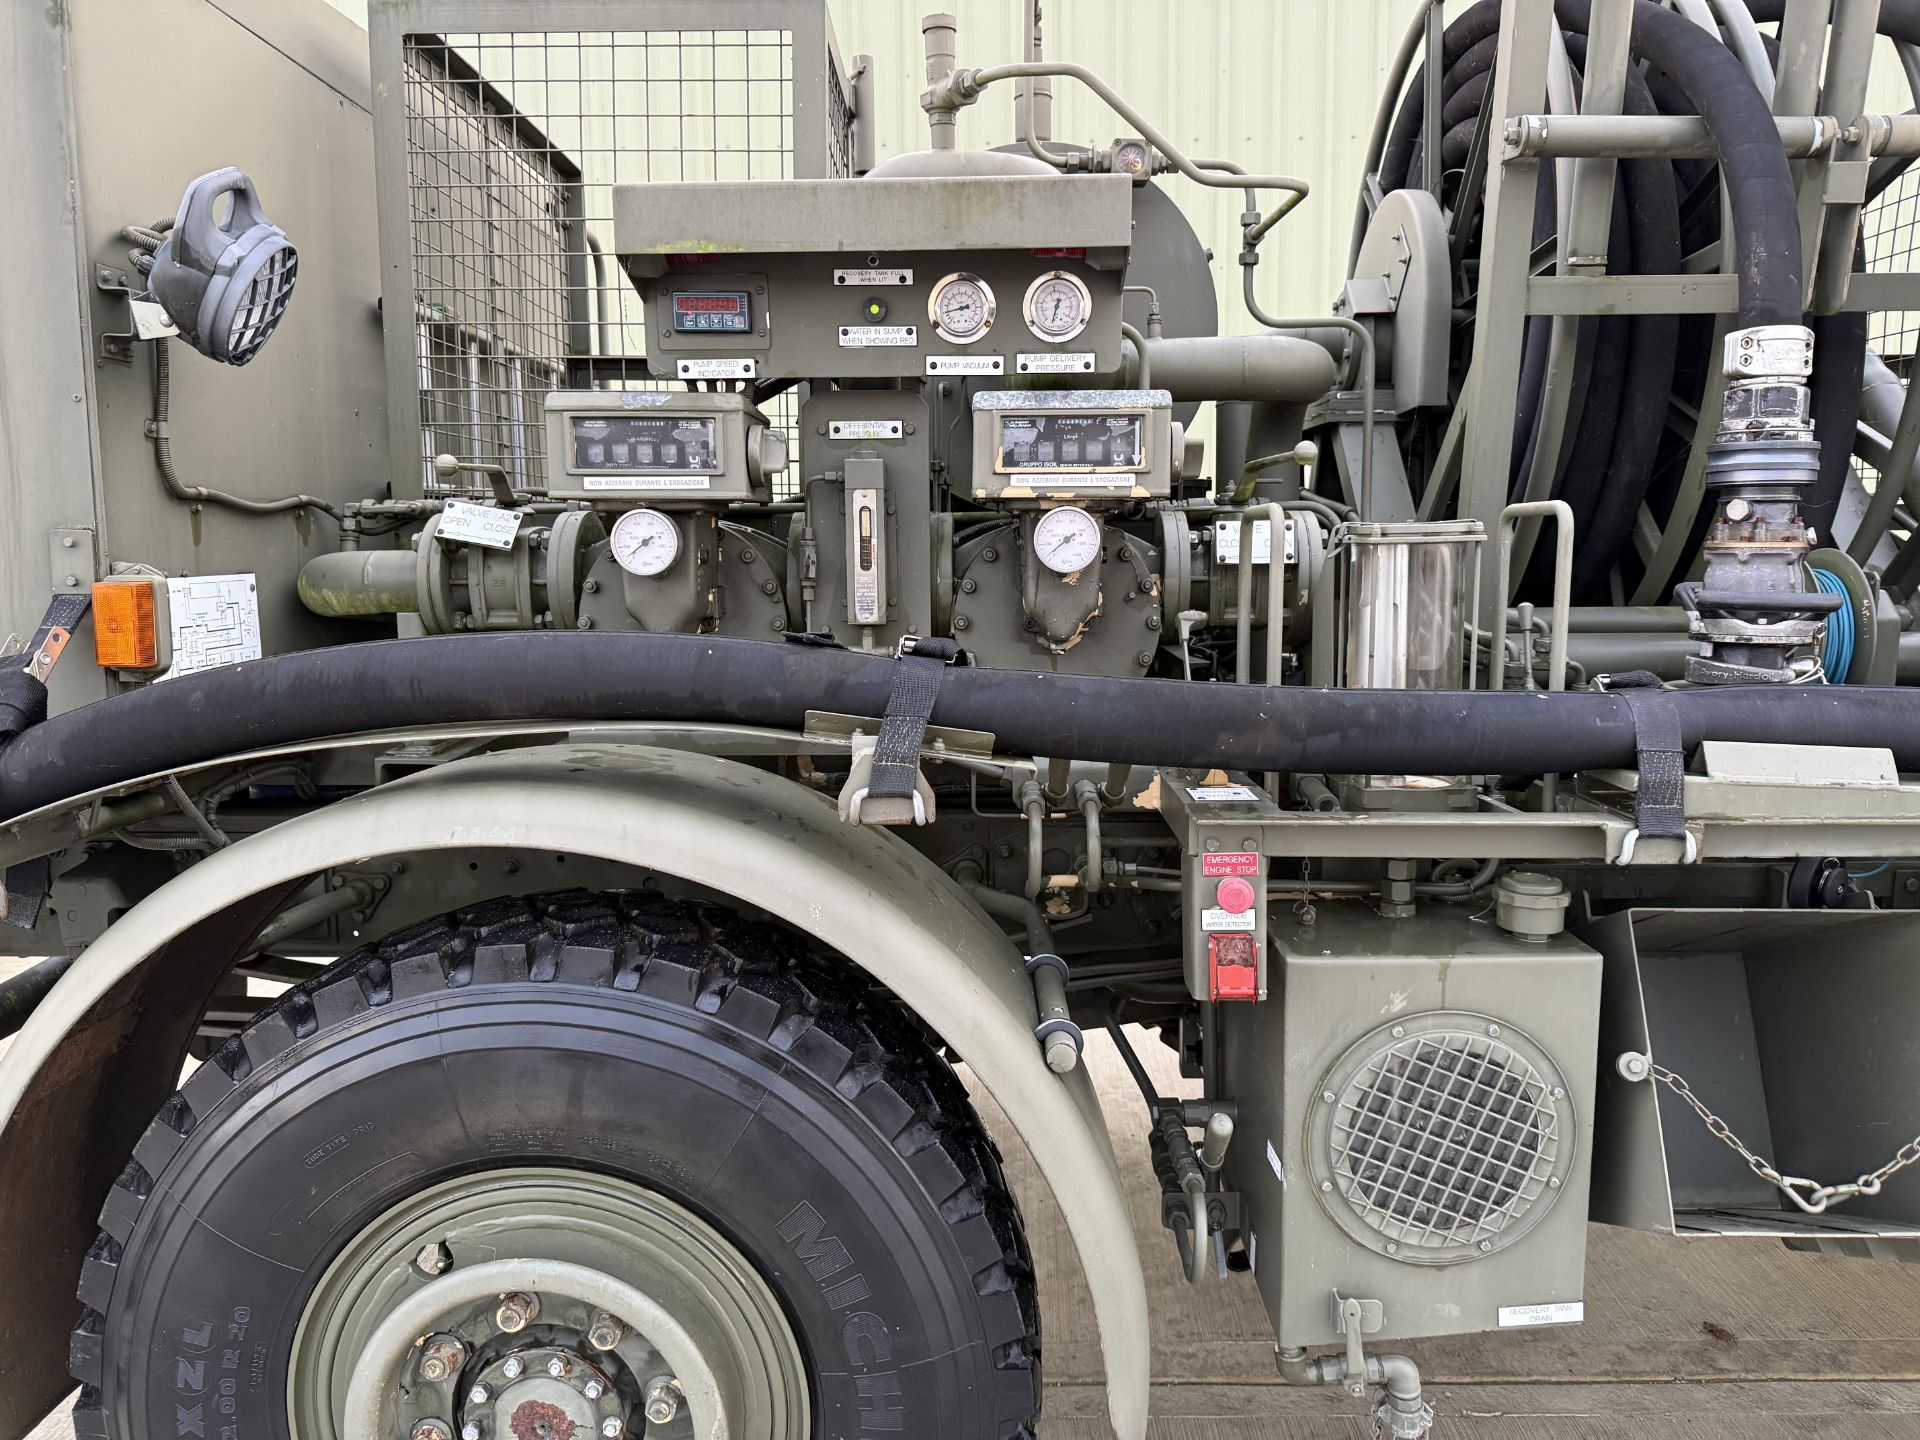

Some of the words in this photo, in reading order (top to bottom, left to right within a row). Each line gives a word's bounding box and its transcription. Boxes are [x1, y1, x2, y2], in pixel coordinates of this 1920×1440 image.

[1049, 354, 1087, 362] DELIVERY
[462, 507, 491, 519] VALVE
[498, 513, 512, 522] A2
[443, 515, 471, 527] OPEN
[483, 522, 516, 534] CLOSE
[1206, 855, 1255, 864] EMERGENCY
[1204, 866, 1233, 874] ENGINE
[1236, 866, 1257, 874] STOP
[325, 1135, 347, 1151] TYPE
[1509, 1306, 1550, 1315] RECOVERY
[1553, 1304, 1574, 1312] TANK
[227, 1306, 251, 1341] 20
[1529, 1315, 1553, 1323] DRAIN
[221, 1349, 241, 1369] R
[175, 1321, 216, 1439] XZL
